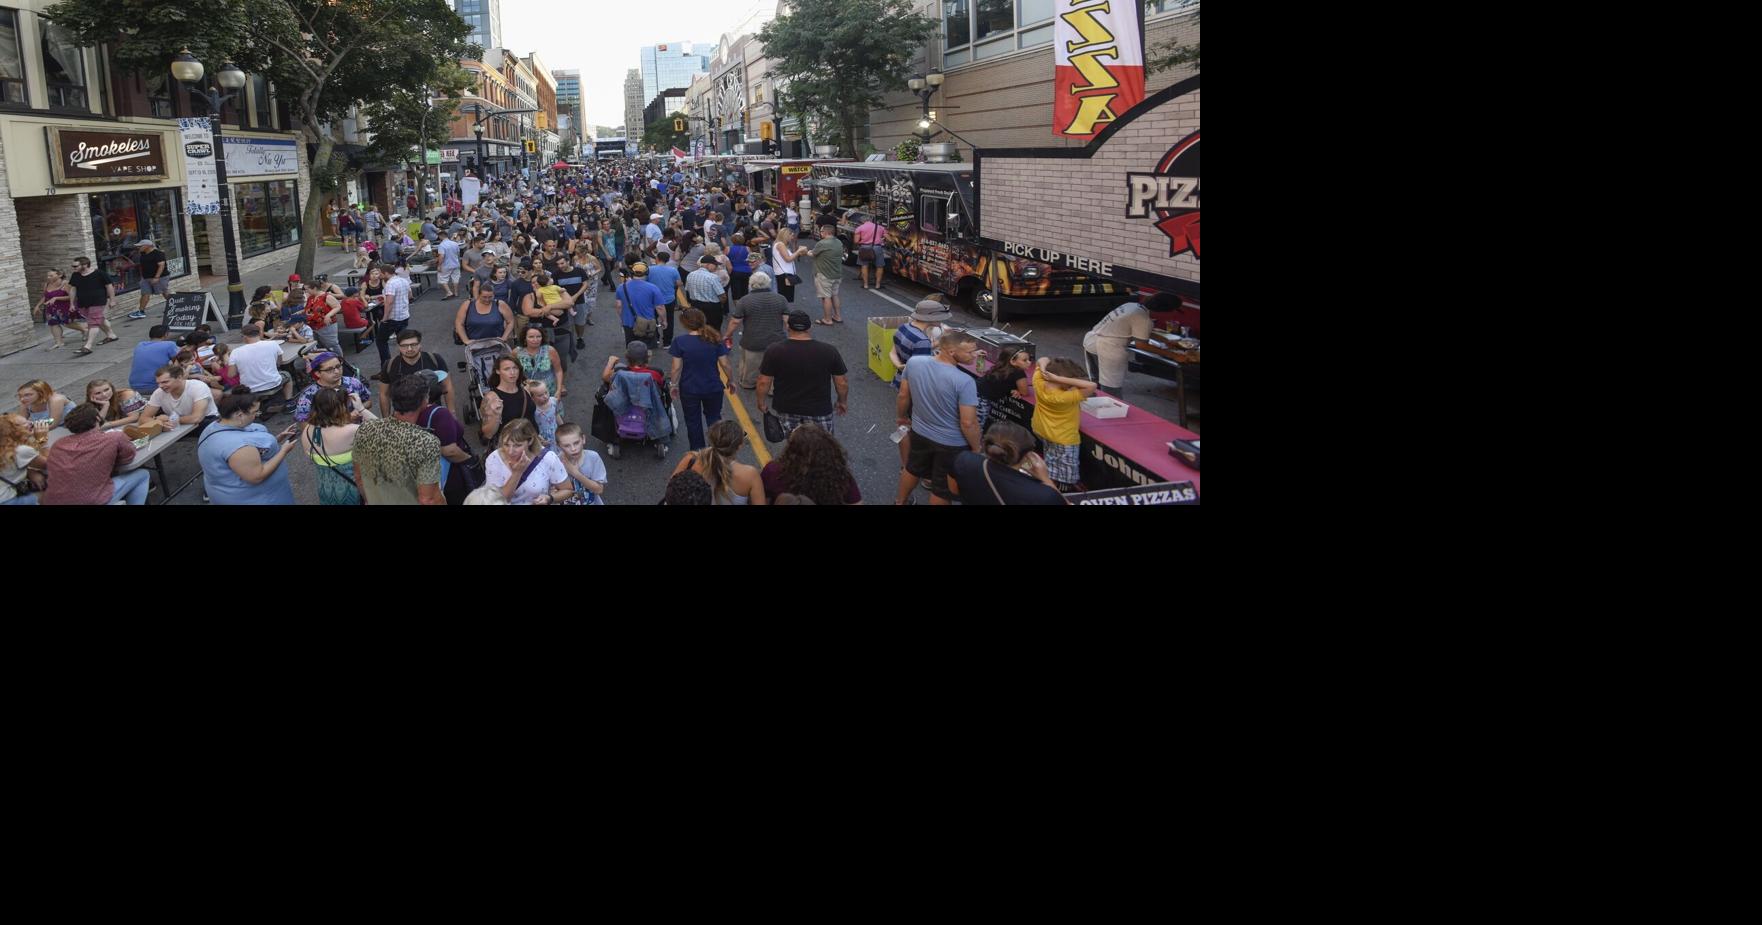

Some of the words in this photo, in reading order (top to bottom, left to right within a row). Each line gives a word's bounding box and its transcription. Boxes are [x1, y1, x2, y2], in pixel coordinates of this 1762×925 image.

[70, 138, 150, 166] Smokeless
[111, 165, 133, 174] VAPE
[136, 165, 157, 173] SHOP
[1127, 173, 1200, 216] PIZ
[1004, 241, 1034, 258] PICK
[1040, 248, 1060, 263] UP
[1066, 254, 1113, 277] HERE
[168, 314, 197, 326] Today
[1092, 444, 1156, 485] John
[1130, 487, 1196, 505] PIZZAS
